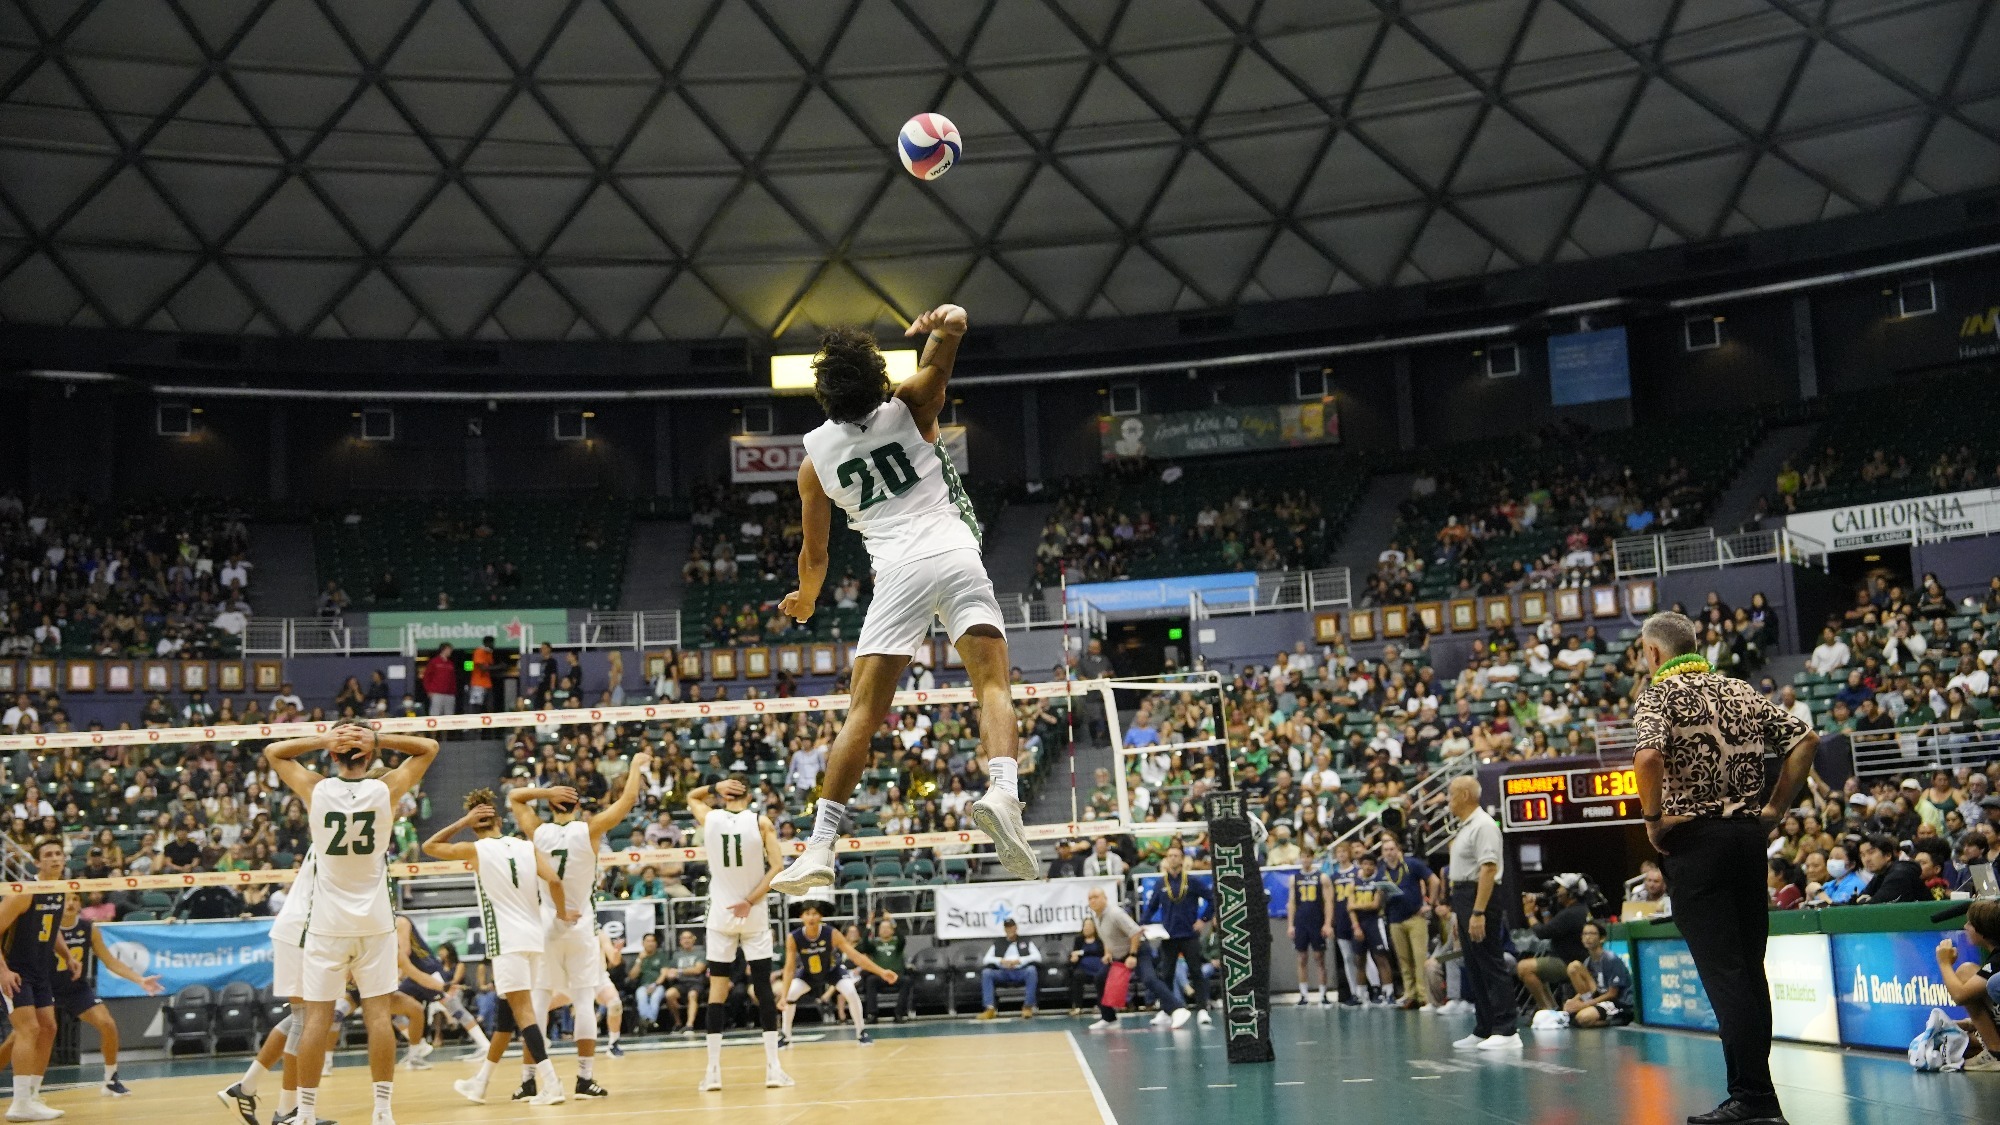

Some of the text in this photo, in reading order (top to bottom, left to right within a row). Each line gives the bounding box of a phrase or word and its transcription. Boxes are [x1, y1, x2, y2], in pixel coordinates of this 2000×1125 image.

[837, 441, 921, 511] 20
[1832, 497, 1965, 533] CALIFORNIA
[408, 622, 498, 639] Heineken
[1594, 770, 1638, 796] 1:30
[1525, 799, 1546, 820] 11
[1619, 801, 1627, 816] 1
[324, 811, 376, 856] 23
[551, 849, 568, 880] 7
[721, 834, 743, 867] 11
[507, 858, 519, 888] 1
[38, 914, 54, 942] 3
[947, 908, 992, 929] Star
[1786, 983, 1816, 1002] Athletics
[1870, 974, 1903, 1004] Bank
[1904, 975, 1917, 1005] of
